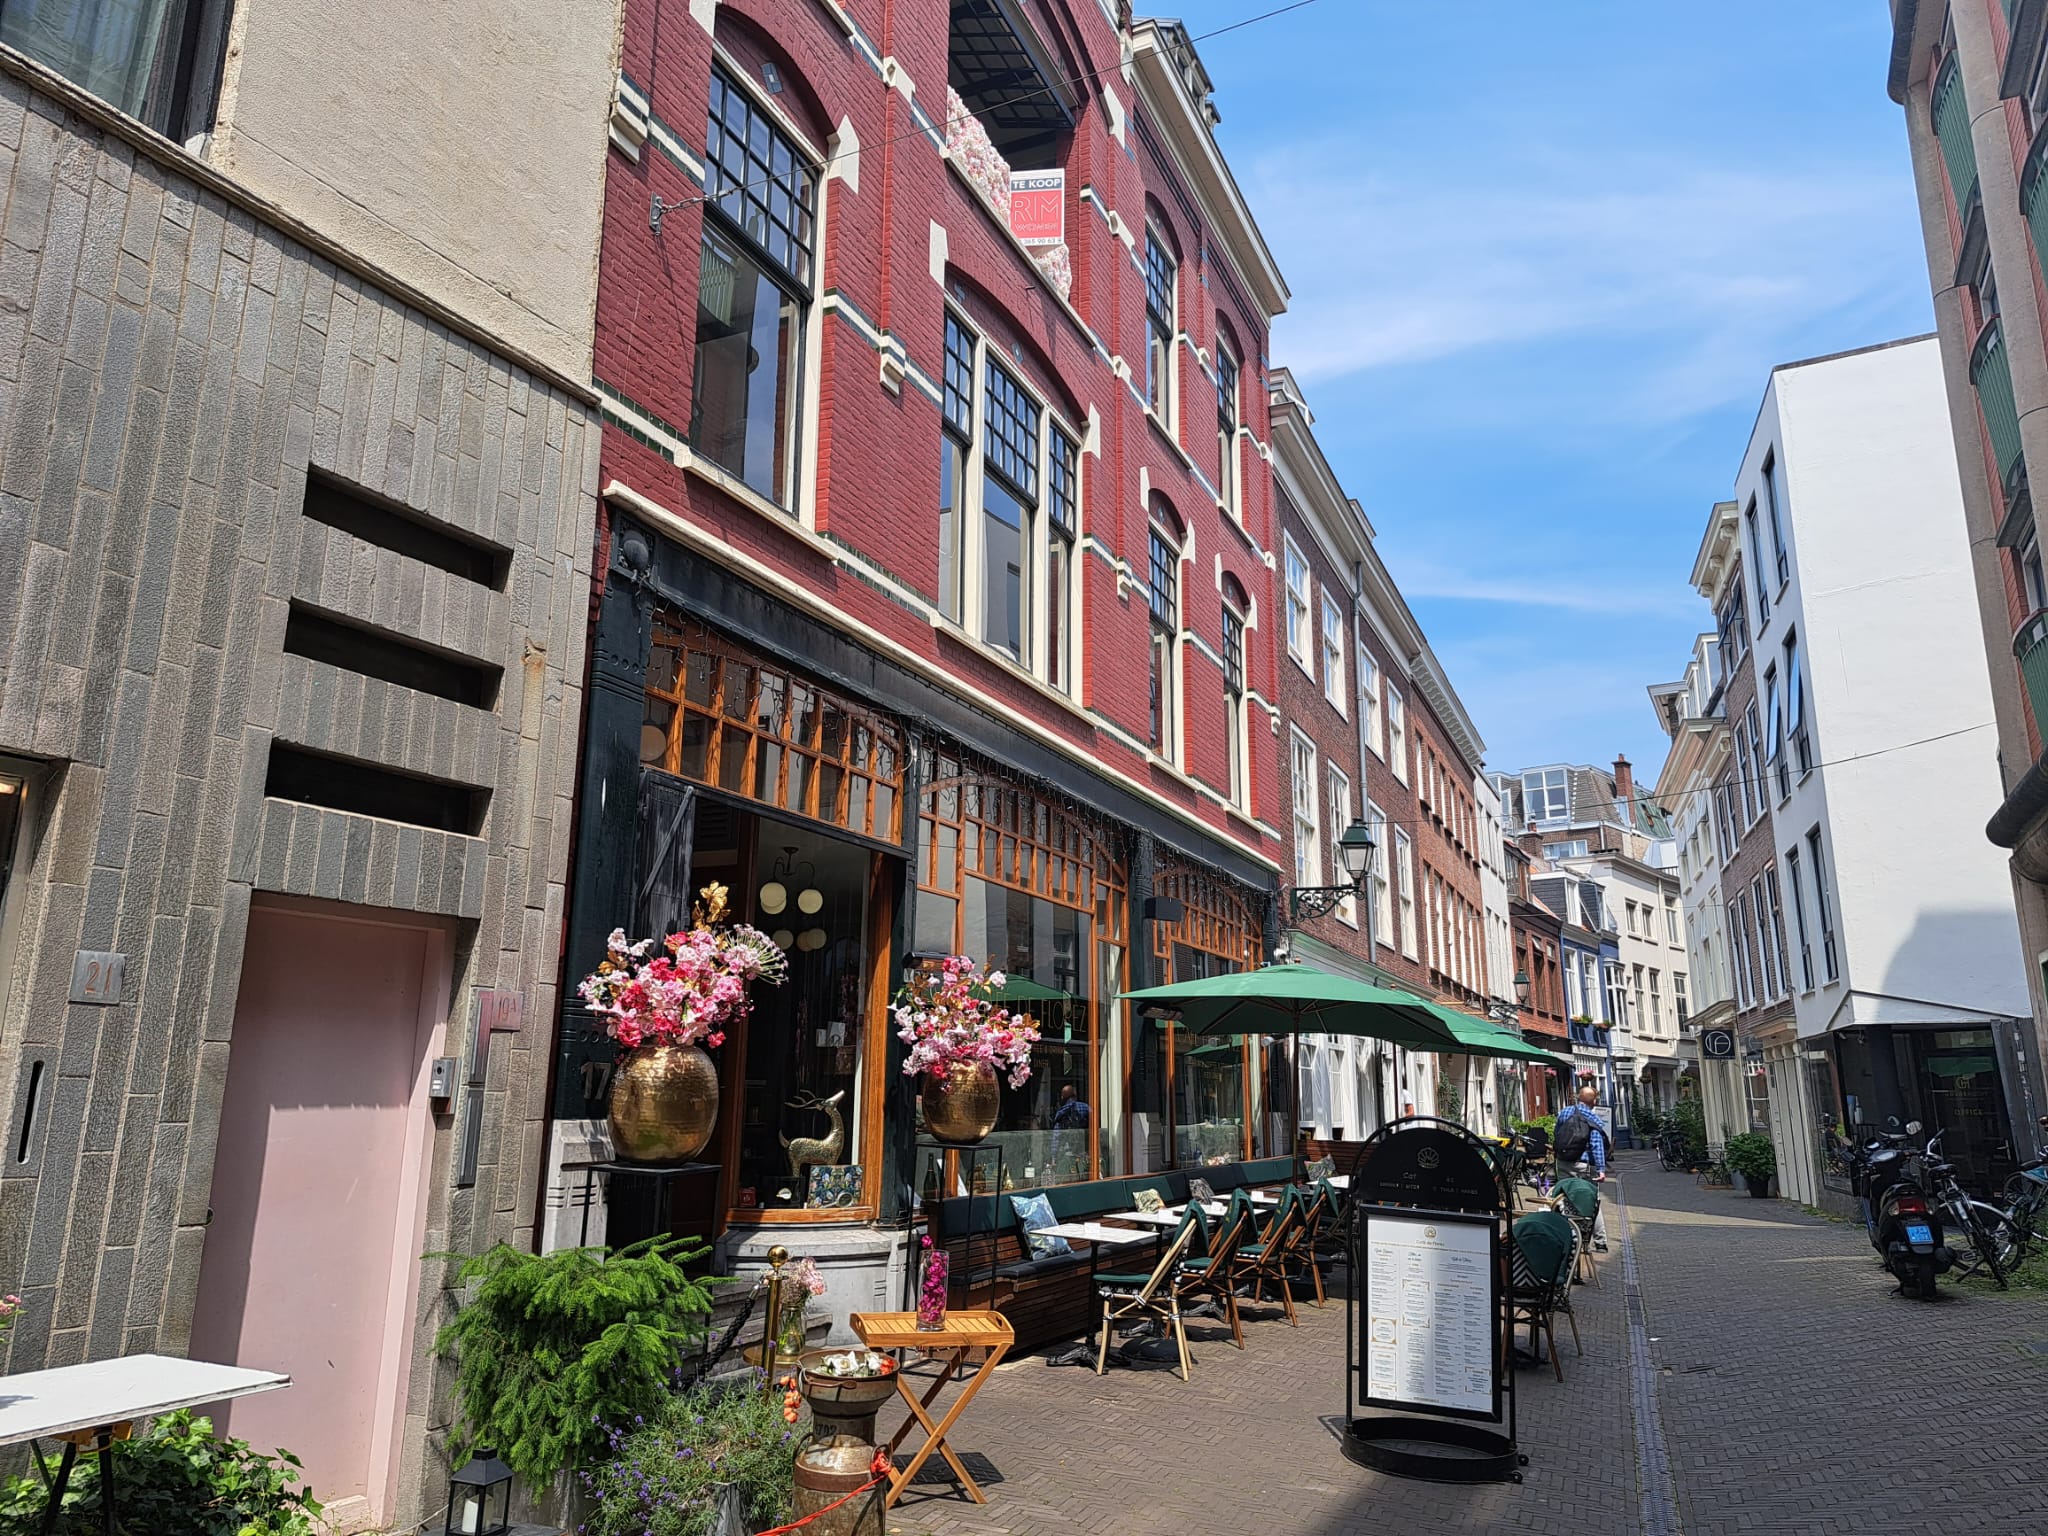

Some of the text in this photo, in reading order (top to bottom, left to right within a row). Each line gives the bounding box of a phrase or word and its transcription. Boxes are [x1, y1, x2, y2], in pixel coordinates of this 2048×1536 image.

[1012, 178, 1061, 189] TE KOOP
[84, 961, 112, 994] 21
[581, 1061, 611, 1100] 17
